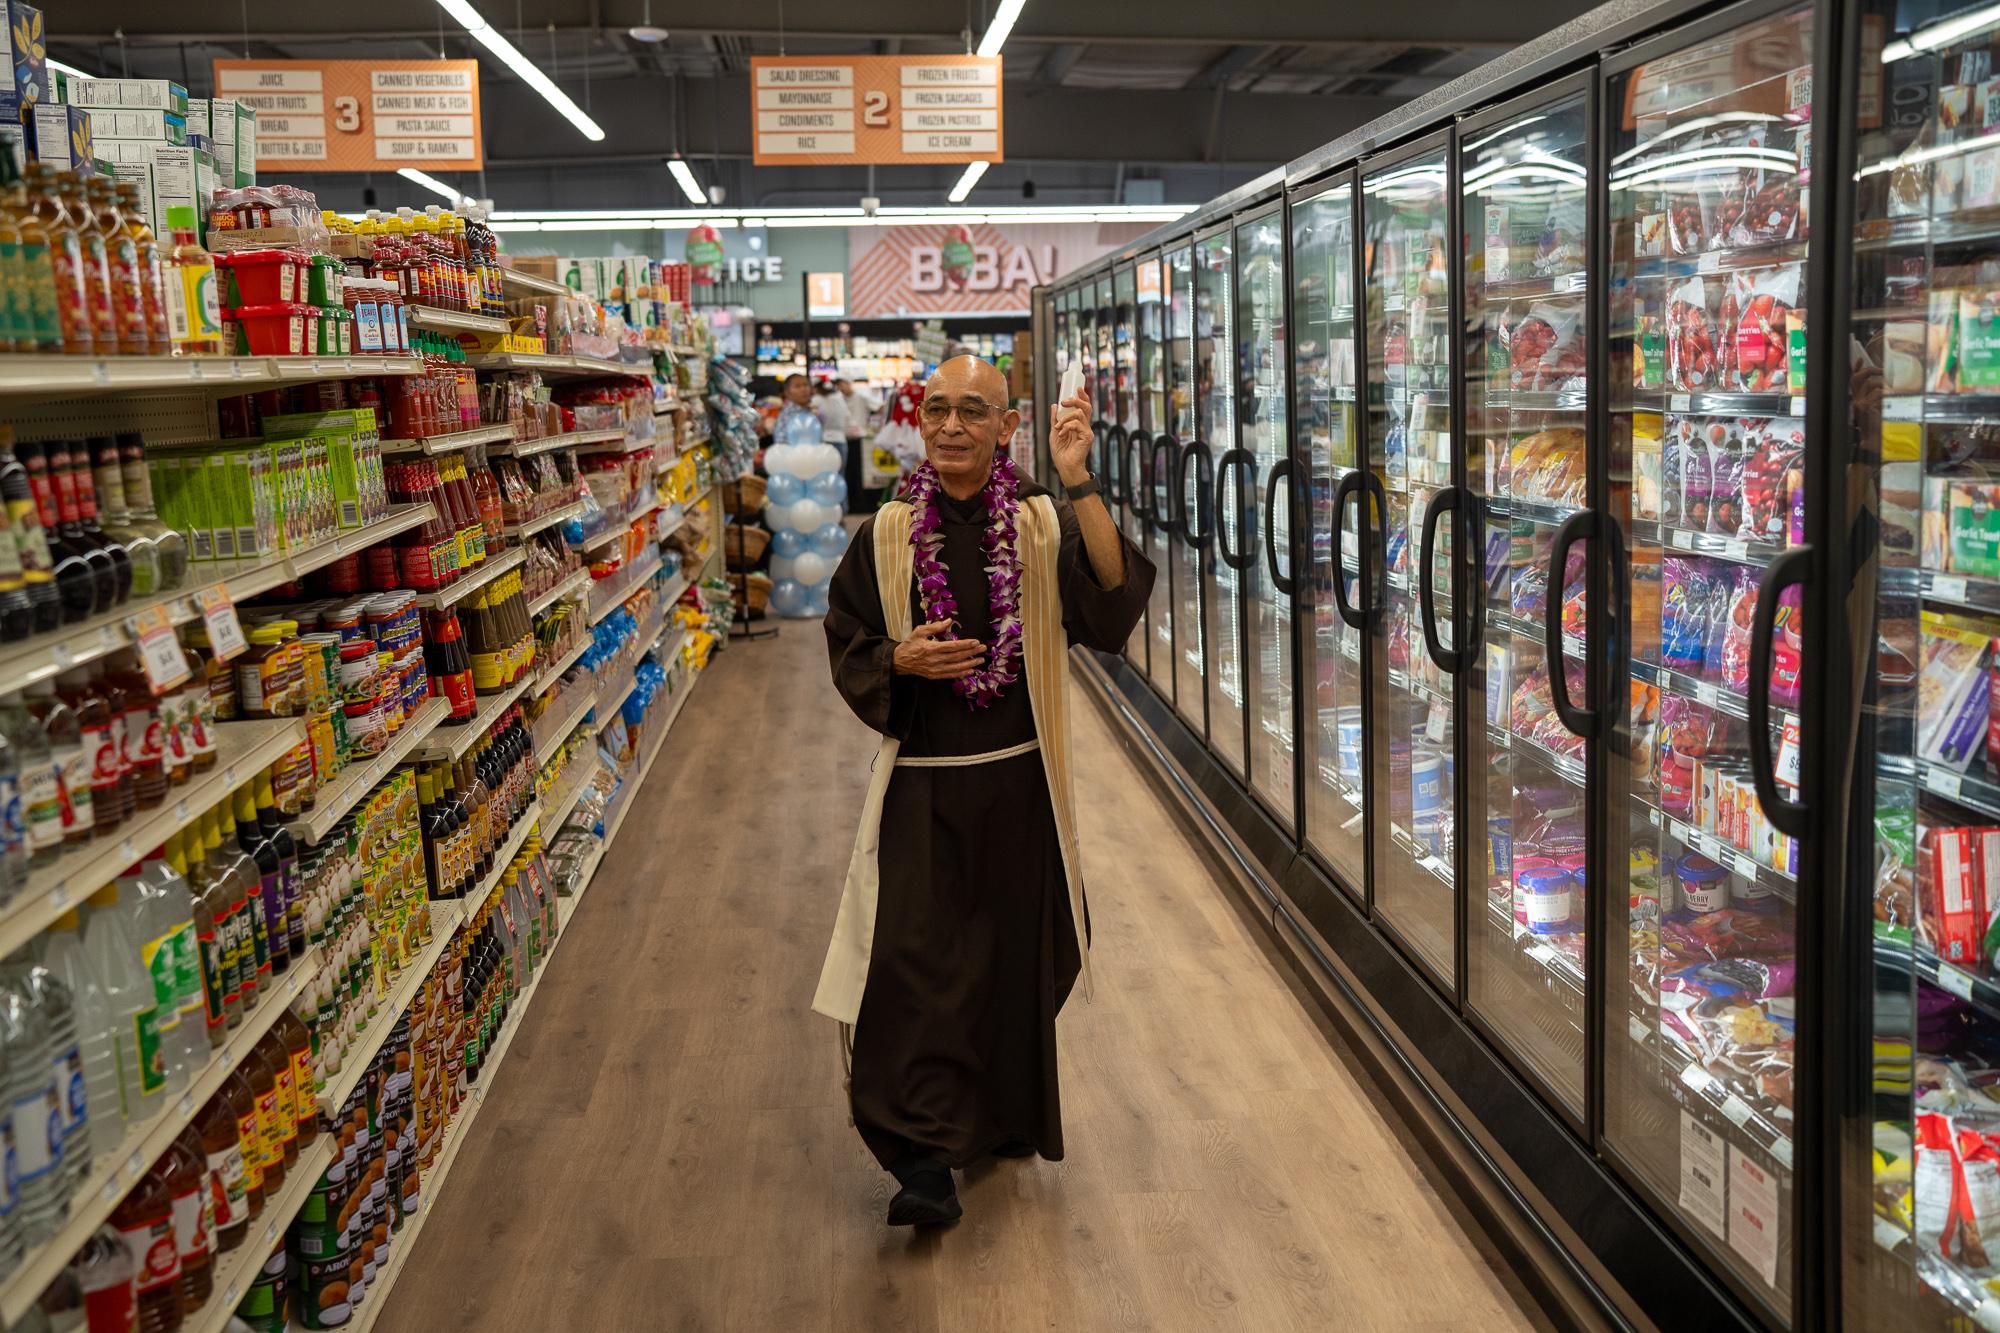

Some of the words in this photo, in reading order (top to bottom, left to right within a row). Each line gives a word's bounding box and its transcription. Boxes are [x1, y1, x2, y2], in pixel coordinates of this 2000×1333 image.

[259, 74, 284, 86] JUICE
[378, 74, 413, 87] CANNED
[415, 74, 465, 86] VEGETABLES
[770, 70, 797, 82] SALAD
[799, 70, 840, 82] DRESSING
[917, 69, 948, 81] FROZEN
[951, 69, 979, 81] FRUITS
[1793, 80, 1811, 94] TEXAS
[277, 97, 307, 109] FRUITS
[377, 96, 412, 109] CANNED
[414, 96, 436, 108] MEAT
[439, 96, 447, 108] &
[449, 95, 469, 108] FISH
[778, 92, 832, 105] MAYONNAISE
[915, 93, 944, 104] FROZEN
[946, 92, 982, 104] SAUSAGES
[1793, 92, 1811, 107] TOAST
[334, 95, 362, 132] 3
[863, 90, 890, 126] 2
[260, 120, 289, 132] BREAD
[396, 120, 422, 132] PASTA
[424, 120, 451, 132] SAUCE
[779, 115, 834, 127] CONDIMENTS
[917, 115, 946, 126] FROZEN
[948, 115, 982, 126] PASTRIES
[797, 137, 816, 149] RICE
[928, 136, 941, 147] ICE
[943, 136, 972, 147] CREAM
[261, 142, 291, 155] BUTTER
[293, 142, 300, 155] &
[302, 142, 323, 155] JELLY
[392, 143, 415, 155] SOUP
[417, 143, 425, 155] &
[427, 142, 458, 154] RAMEN
[716, 256, 783, 283] ICE
[911, 244, 1056, 291] BBA!
[818, 280, 832, 303] 1
[1690, 895, 1708, 904] BERRY
